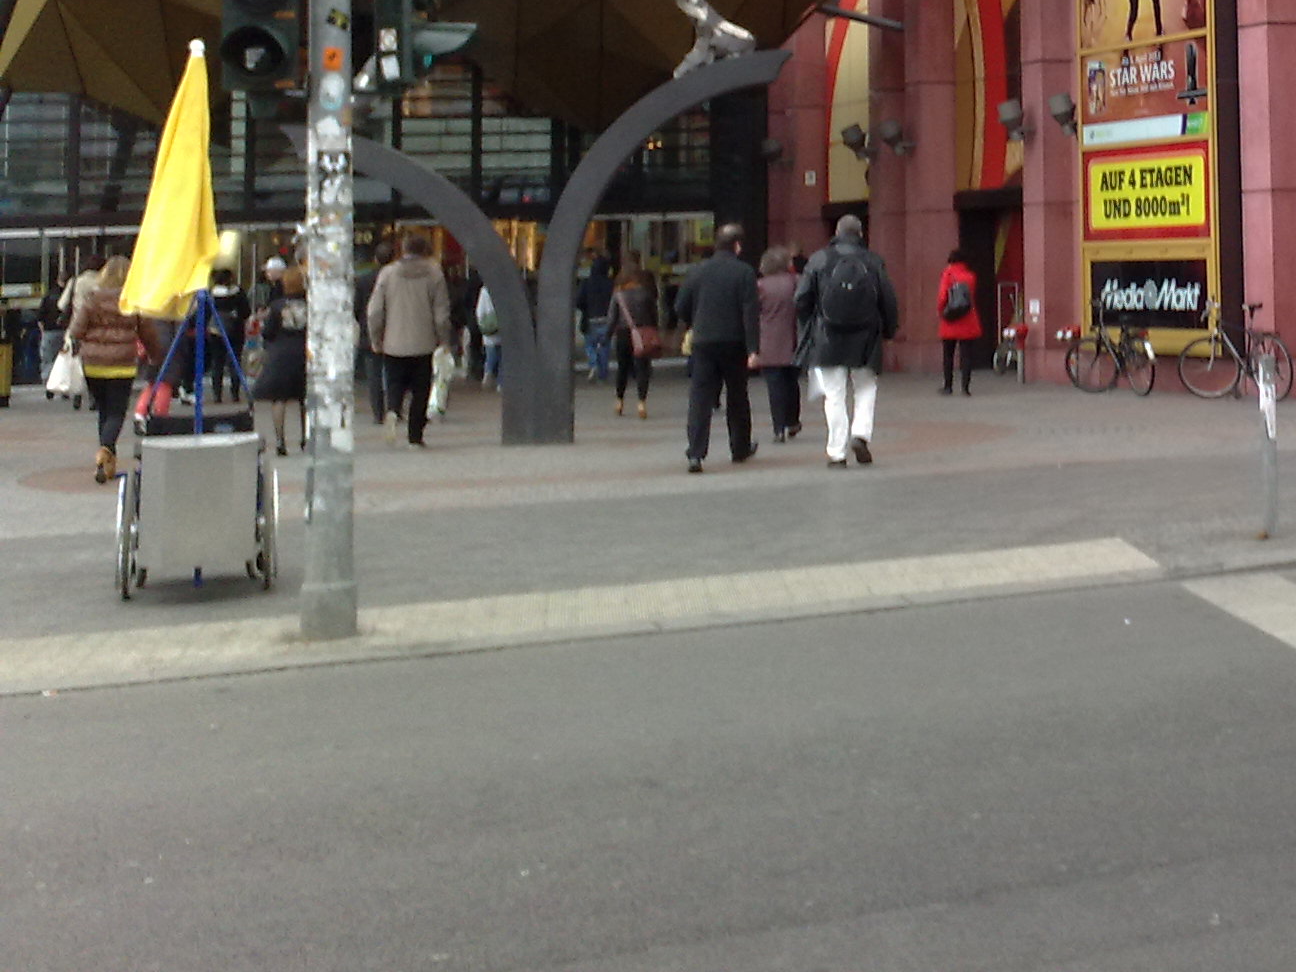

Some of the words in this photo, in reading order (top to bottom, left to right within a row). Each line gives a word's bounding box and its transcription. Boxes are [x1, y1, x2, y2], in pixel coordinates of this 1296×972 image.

[1109, 65, 1138, 88] STAR
[1140, 59, 1175, 84] WARS
[1100, 170, 1125, 192] AUF
[1128, 168, 1137, 190] 4
[1139, 164, 1193, 189] ETAGEN
[1103, 198, 1132, 219] UND
[1155, 277, 1201, 311] Markt
